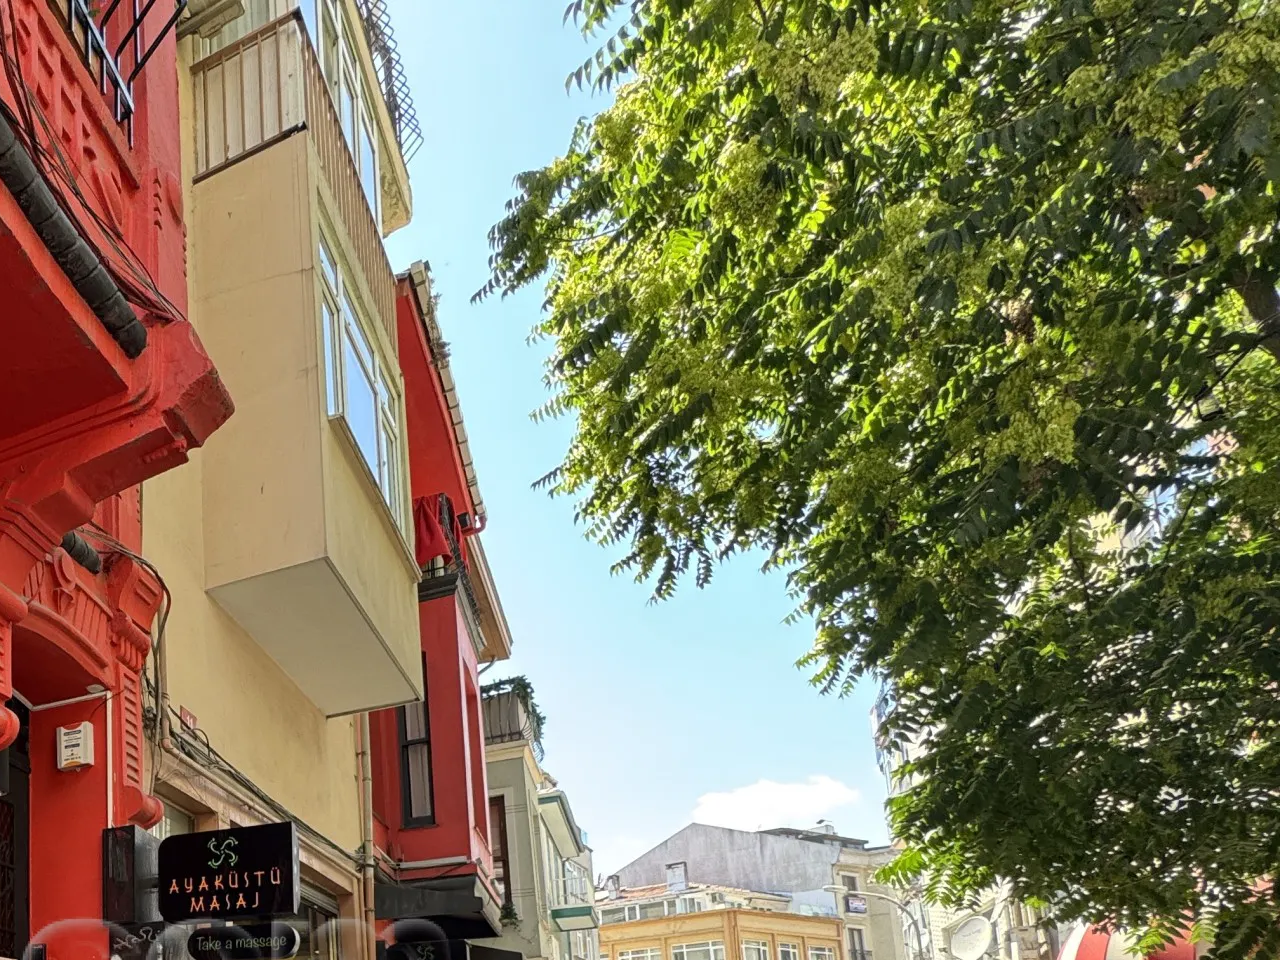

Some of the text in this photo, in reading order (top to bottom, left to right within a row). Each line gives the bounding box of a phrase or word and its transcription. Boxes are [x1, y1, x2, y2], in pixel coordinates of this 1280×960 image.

[169, 867, 281, 895] AYAKÜSTÜ
[190, 892, 259, 913] MASAJ
[196, 935, 287, 953] Take a massage
